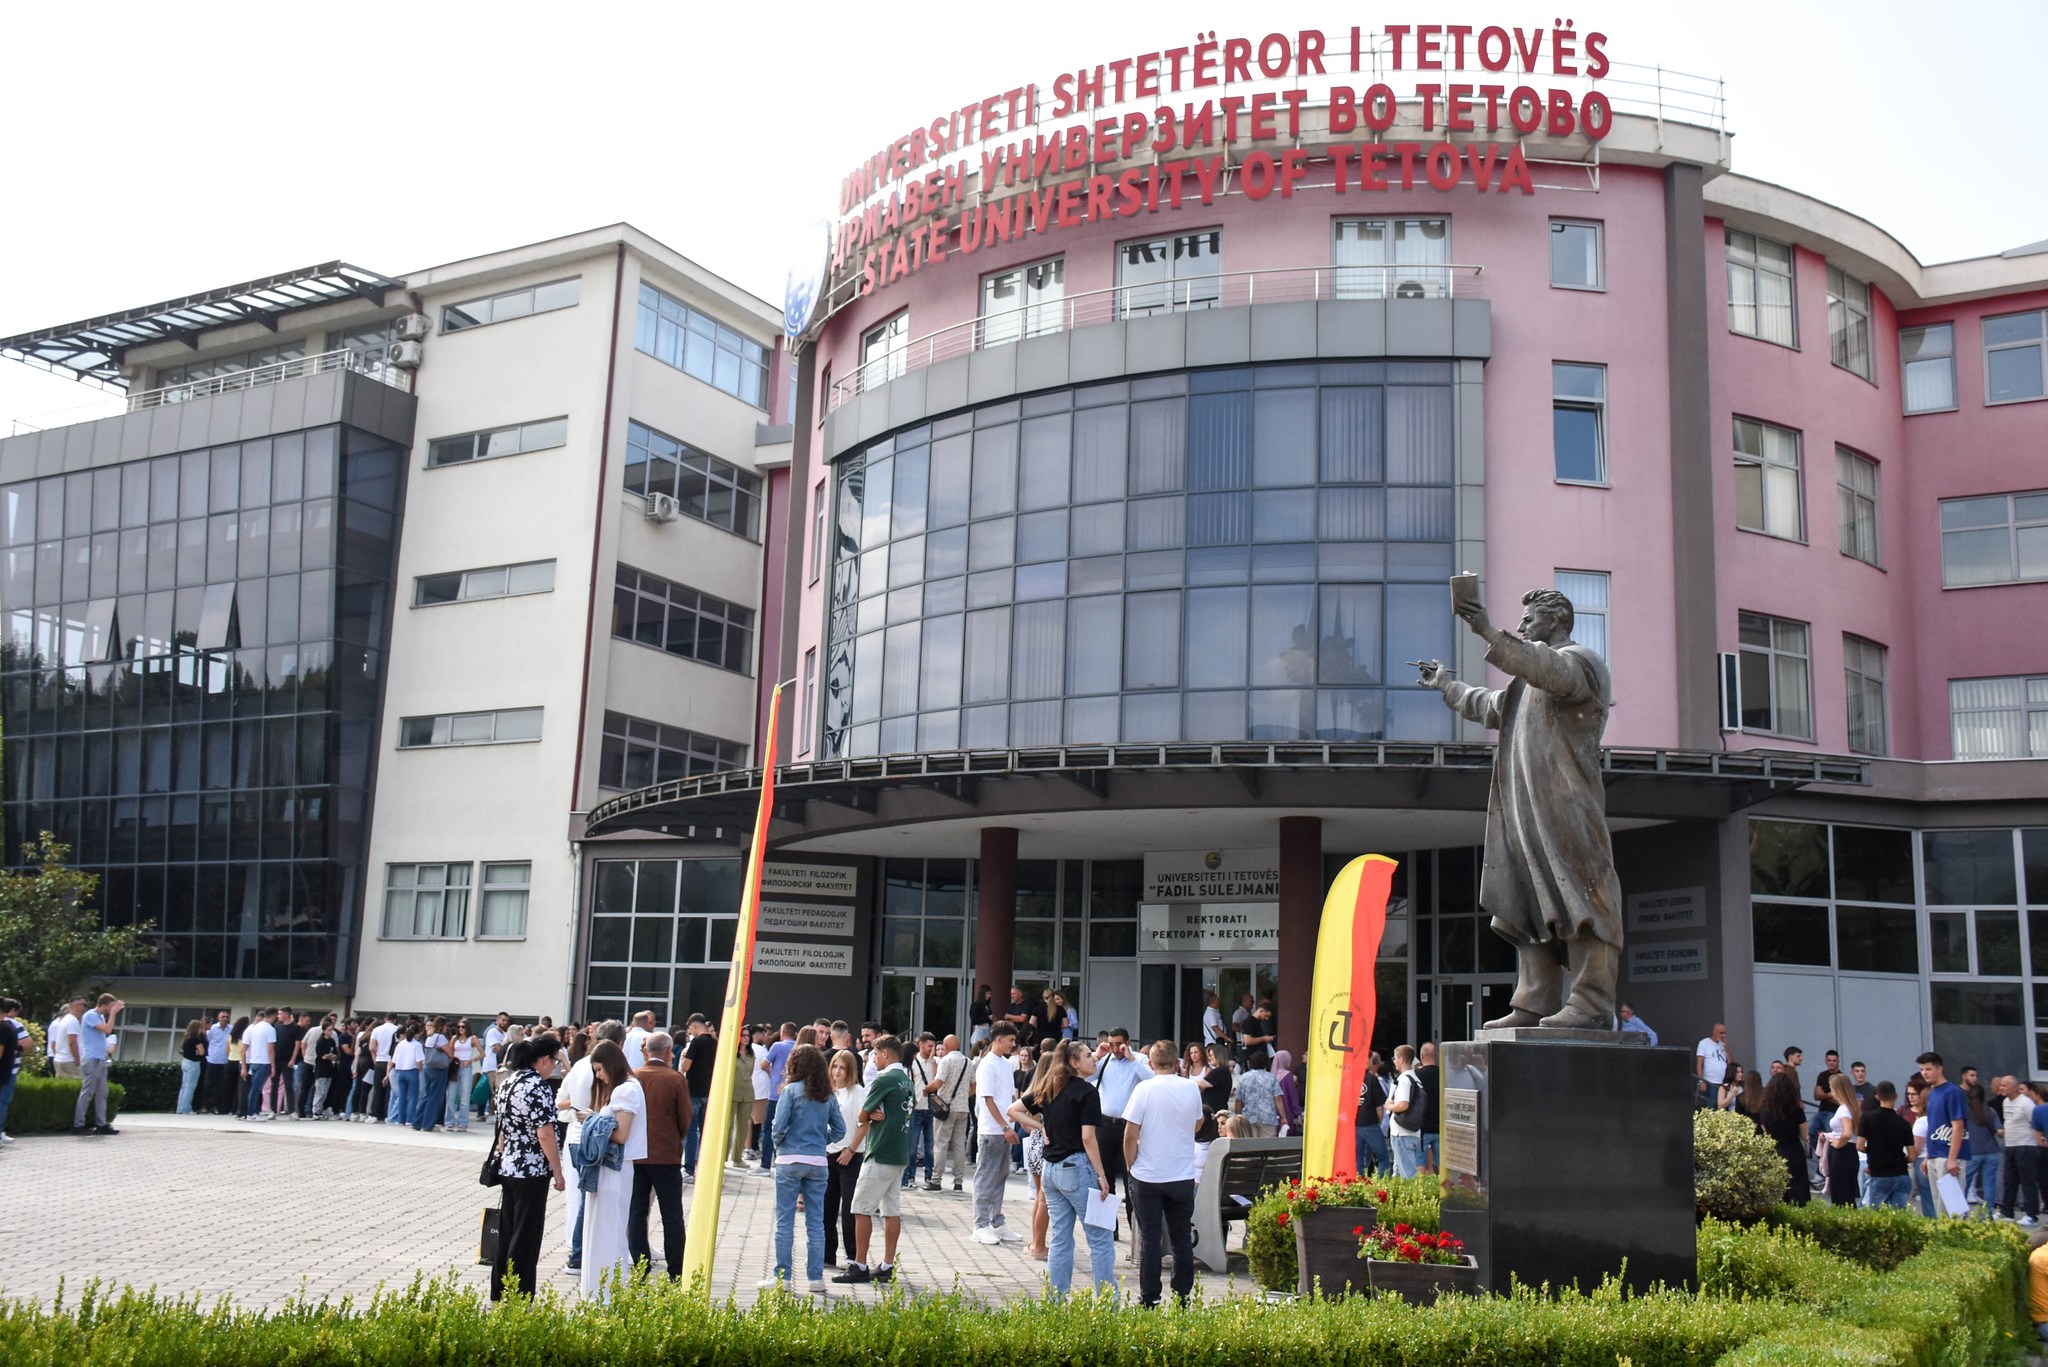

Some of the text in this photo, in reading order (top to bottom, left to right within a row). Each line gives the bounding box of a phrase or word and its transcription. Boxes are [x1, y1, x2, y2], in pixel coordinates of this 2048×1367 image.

[839, 18, 1610, 215] UNIVERSITETI SHTETËROR I TETOVËS
[830, 83, 1613, 275] ДРЖАВЕН УНИВЕРЗИТЕТ ВО ТЕТОВО
[862, 217, 949, 297] STATE
[959, 156, 1224, 255] UNIVERSITY
[1240, 148, 1307, 200] OF
[1327, 141, 1535, 195] TETOVA
[768, 868, 847, 880] FAKULTETI FILOZOFIK
[1157, 871, 1225, 883] UNIVERSITETI
[1233, 868, 1279, 880] TETOVËS
[761, 879, 853, 891] ФИЛОЗОФСКИ ФАКУЛТЕТ
[763, 906, 847, 918] FAKULTETI PEDAGOGJIK
[764, 918, 845, 929] ПЕДАГОШКИ ФАКУЛТЕТ
[1186, 915, 1247, 924] REKTORATI
[760, 947, 845, 959] FAKULTETI FILOLOGJIK
[809, 961, 847, 970] ФАКУЛТЕТ
